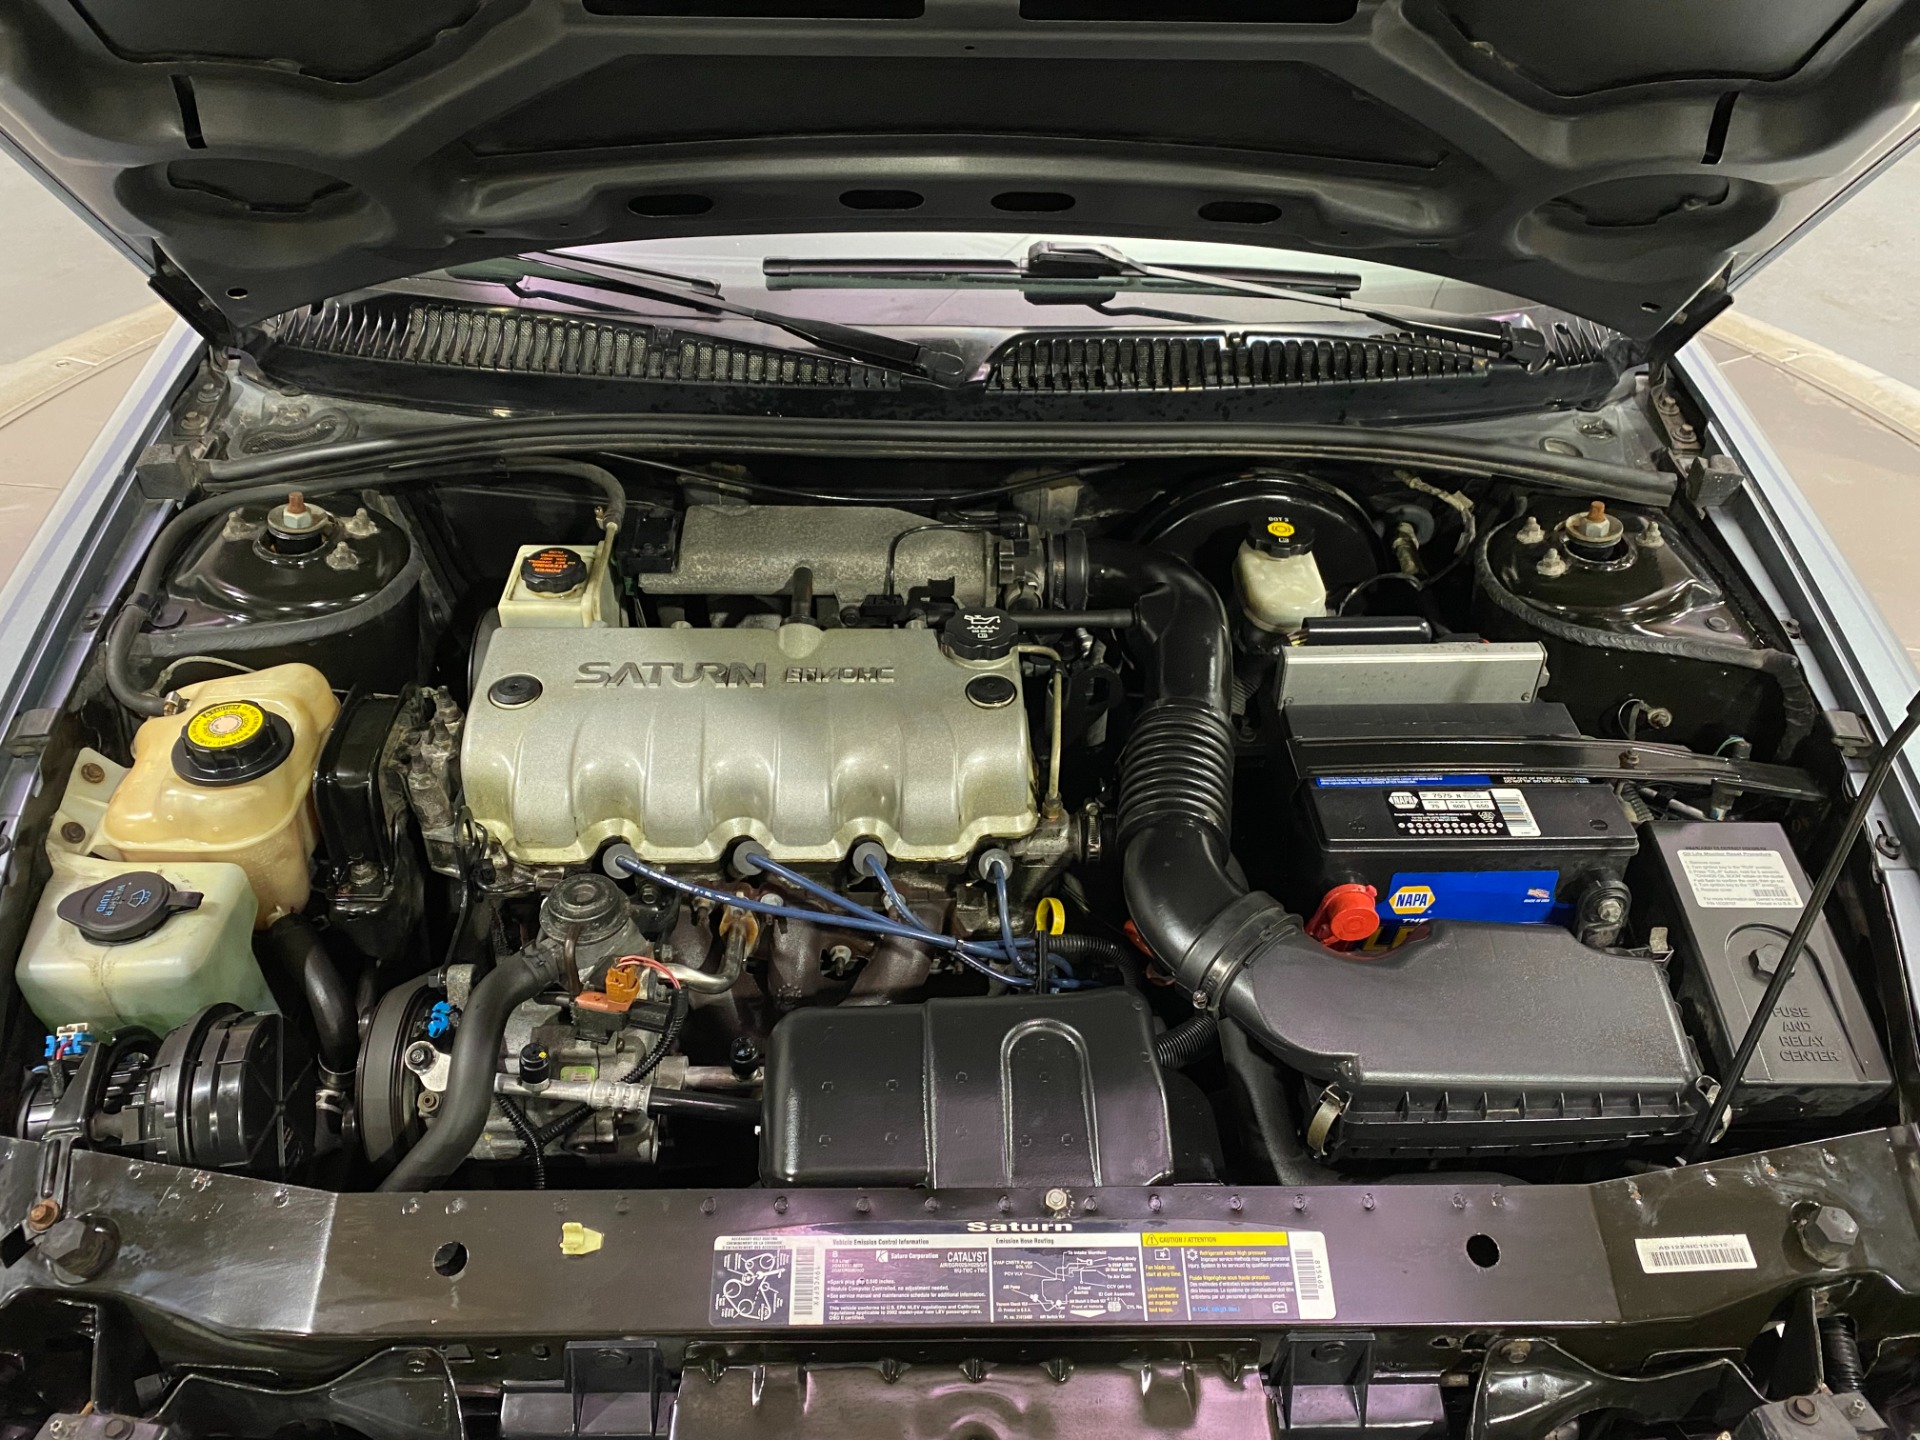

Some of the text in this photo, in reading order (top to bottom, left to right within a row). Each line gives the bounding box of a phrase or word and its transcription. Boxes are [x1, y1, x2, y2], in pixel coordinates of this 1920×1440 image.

[574, 662, 767, 688] SATURN
[96, 890, 114, 912] FLUID
[104, 884, 126, 916] WASHER
[1396, 894, 1428, 907] NAPA
[1772, 1006, 1810, 1018] FUSE
[1782, 1021, 1811, 1033] AND
[1779, 1035, 1826, 1047] RELAY
[1780, 1050, 1839, 1062] CENTER
[967, 1222, 1072, 1232] Saturn
[947, 1252, 987, 1262] CATALYST
[1314, 1260, 1325, 1290] 815460
